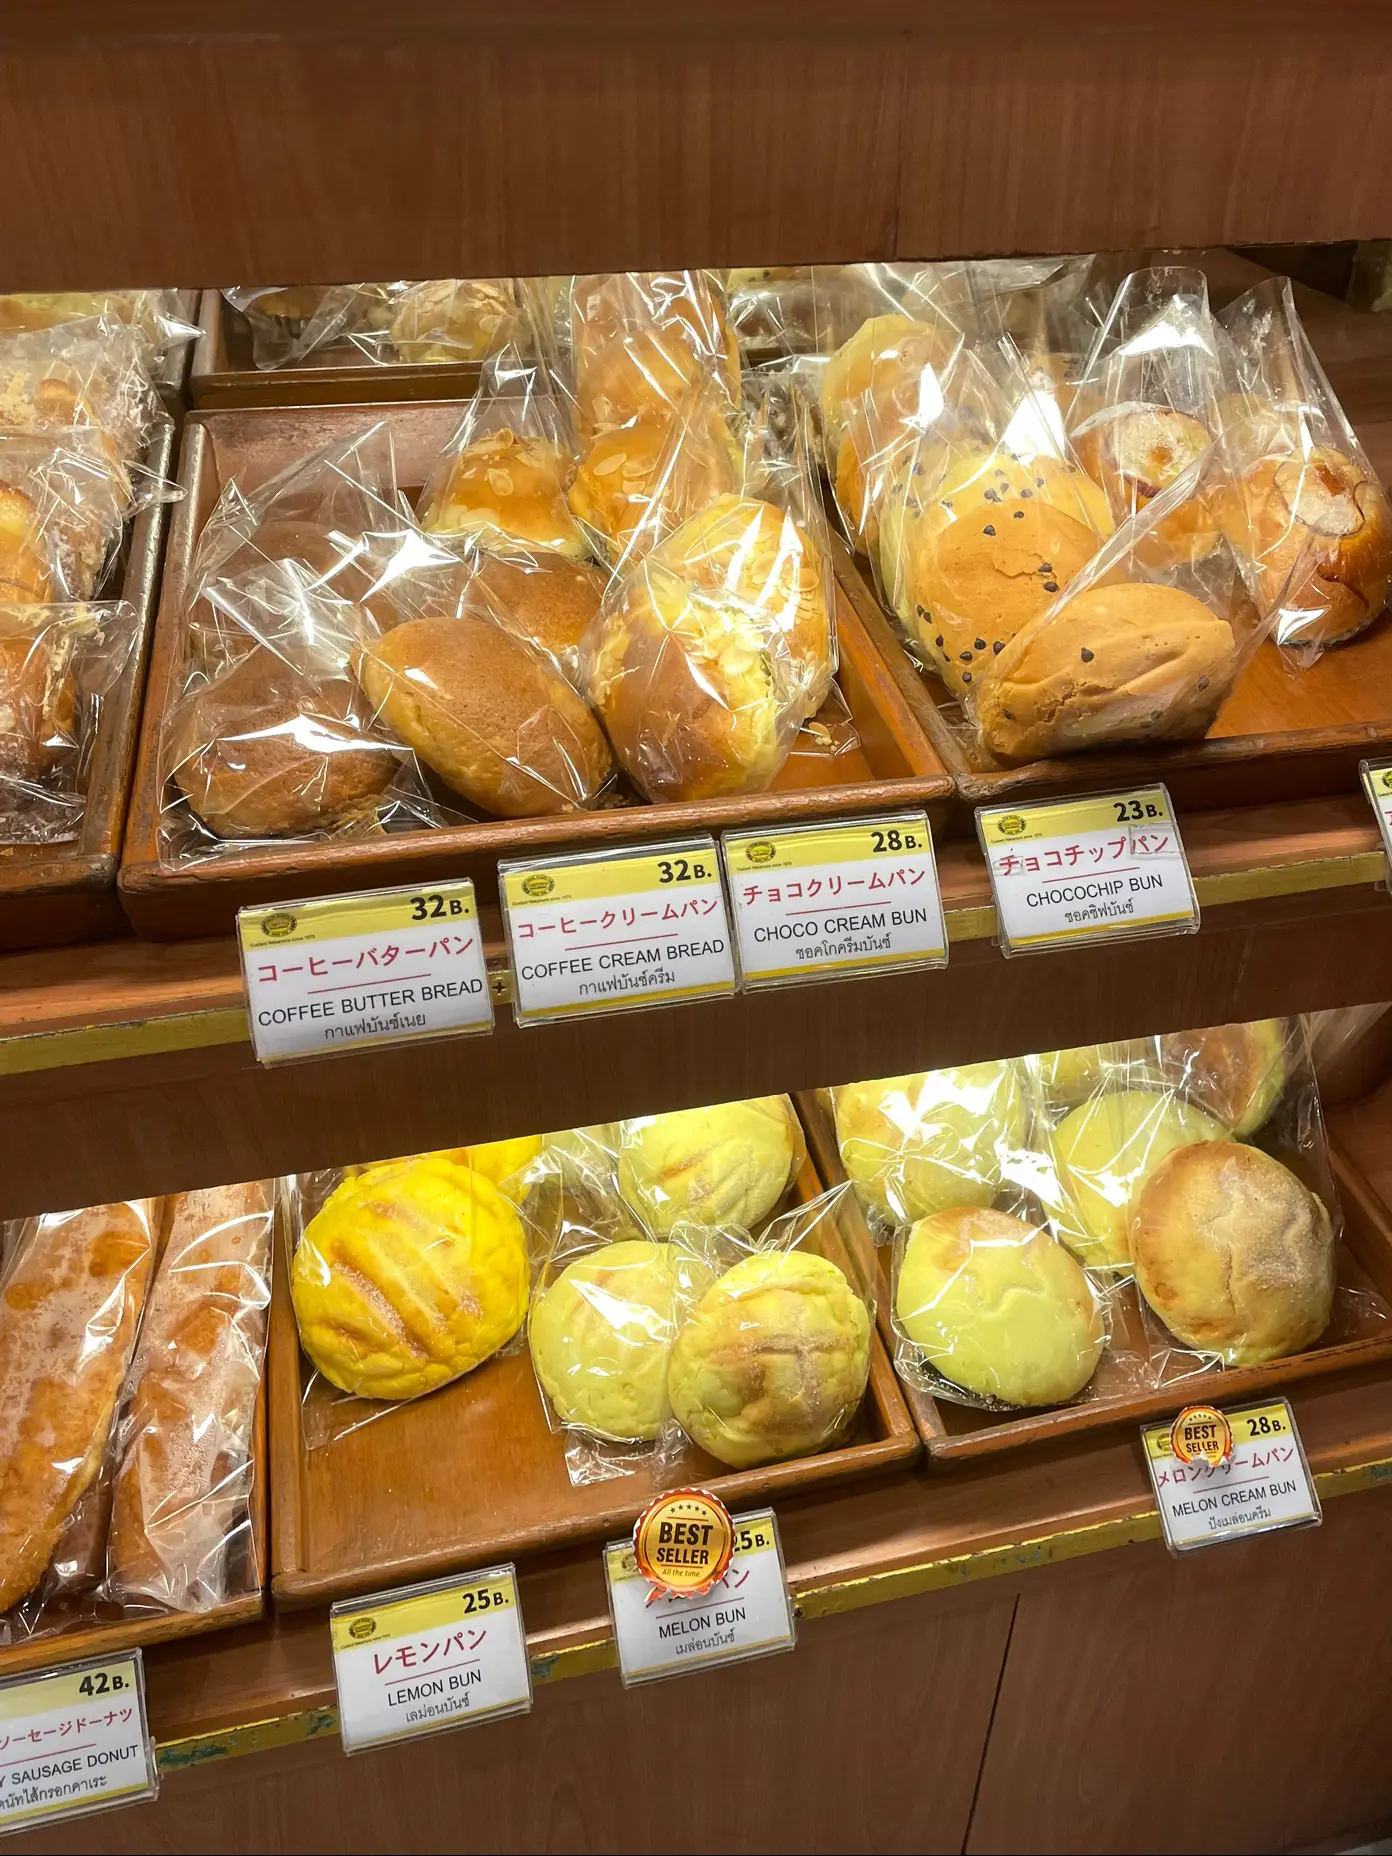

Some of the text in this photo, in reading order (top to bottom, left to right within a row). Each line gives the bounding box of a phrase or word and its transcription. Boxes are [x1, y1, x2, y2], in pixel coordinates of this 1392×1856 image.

[999, 835, 1169, 876] チョコチップパン
[743, 867, 926, 906] チョコクリームパン
[1026, 873, 1163, 908] CHOCOCHIP BUN
[518, 898, 718, 939] コーヒークリームパン
[754, 908, 927, 942] CHOCO CREAM BUN
[258, 937, 473, 982] コーヒーバターパン
[521, 939, 725, 980] COFFEE CREAM BREAD
[258, 979, 483, 1026] COFFEE BUTTER BREAD
[1184, 1424, 1217, 1440] BEST
[1186, 1441, 1219, 1453] SELLER
[1172, 1480, 1297, 1518] MELON CREAM BUN
[658, 1522, 713, 1546] BEST
[656, 1547, 709, 1565] SELLER
[662, 1568, 671, 1576] All
[672, 1568, 683, 1576] the
[659, 1607, 746, 1639] MELON BUN
[373, 1630, 487, 1675] レモンパン
[387, 1669, 482, 1707] LEMON BUN
[12, 1758, 83, 1784] SAUSAGE
[87, 1745, 138, 1768] DONUT
